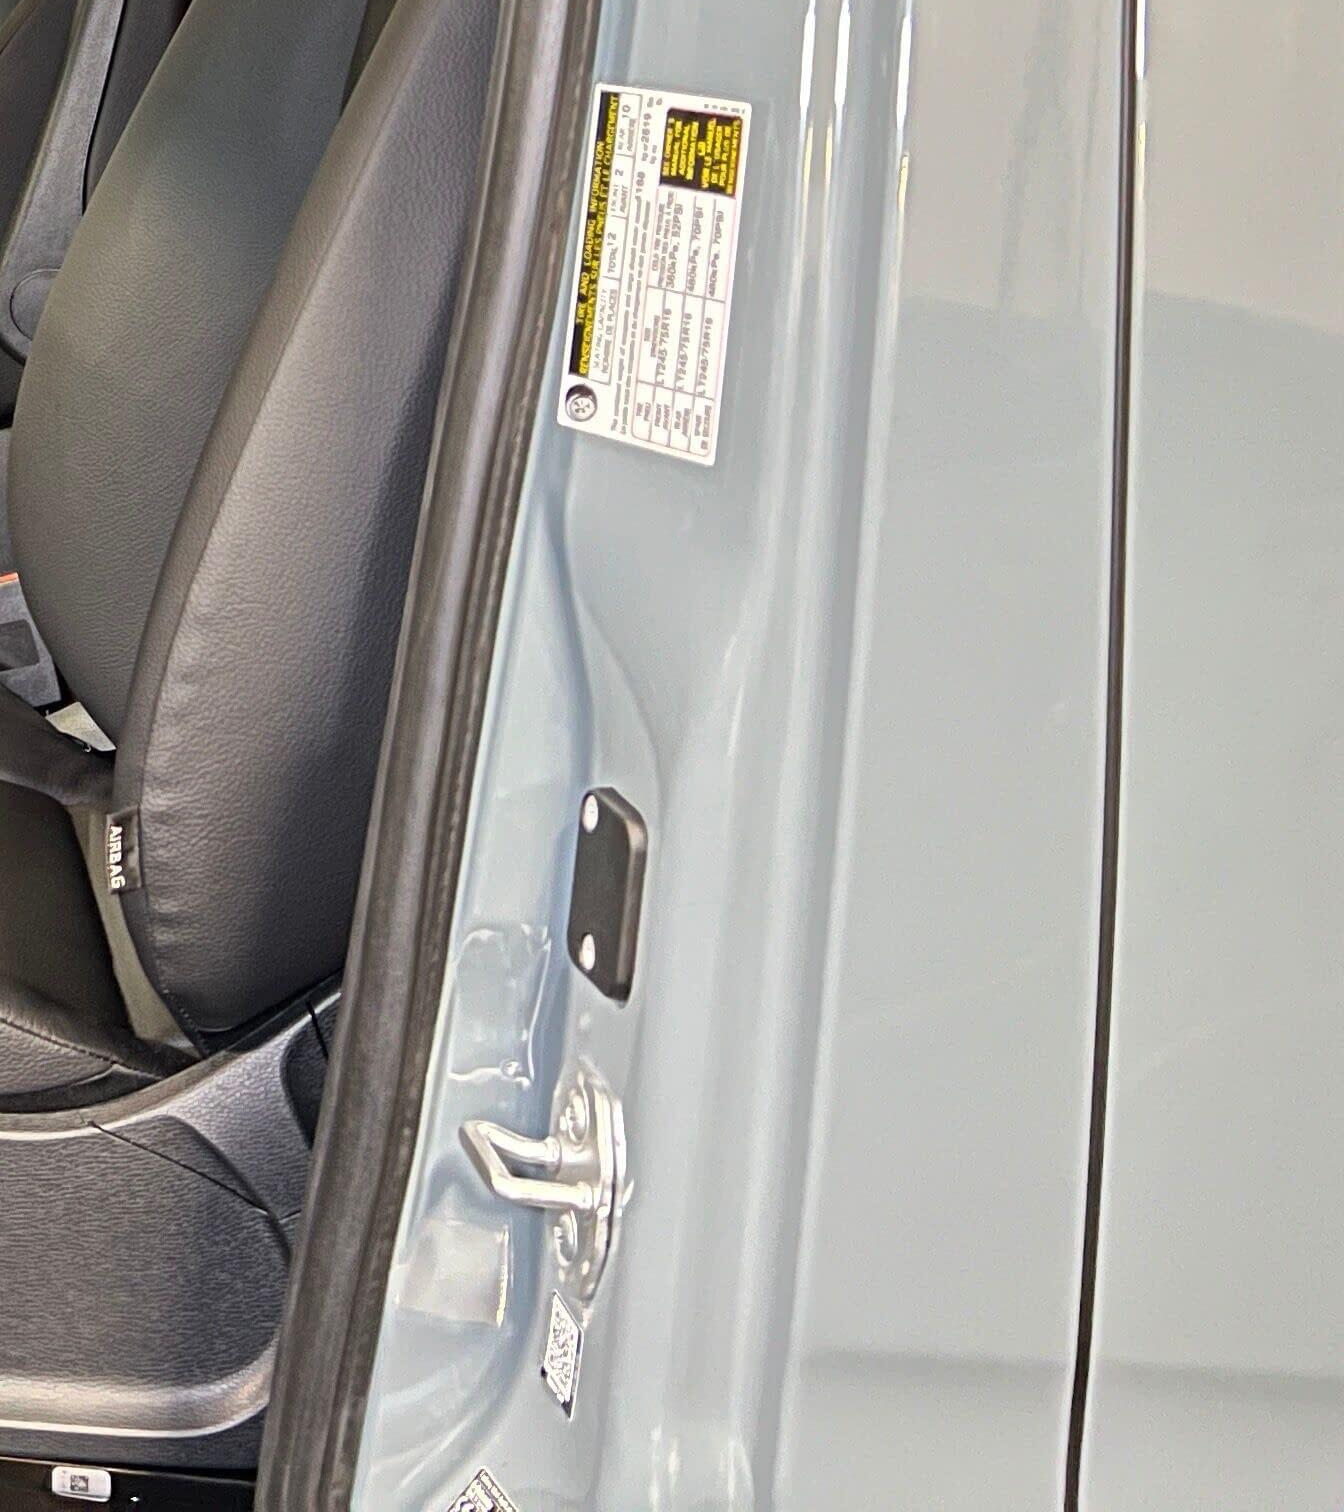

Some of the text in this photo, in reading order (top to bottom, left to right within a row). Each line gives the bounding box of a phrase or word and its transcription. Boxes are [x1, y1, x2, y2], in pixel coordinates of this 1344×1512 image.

[587, 139, 606, 212] INFORMATION
[581, 218, 596, 266] LOADING
[578, 271, 590, 296] AND
[107, 824, 126, 890] AIRBAG
